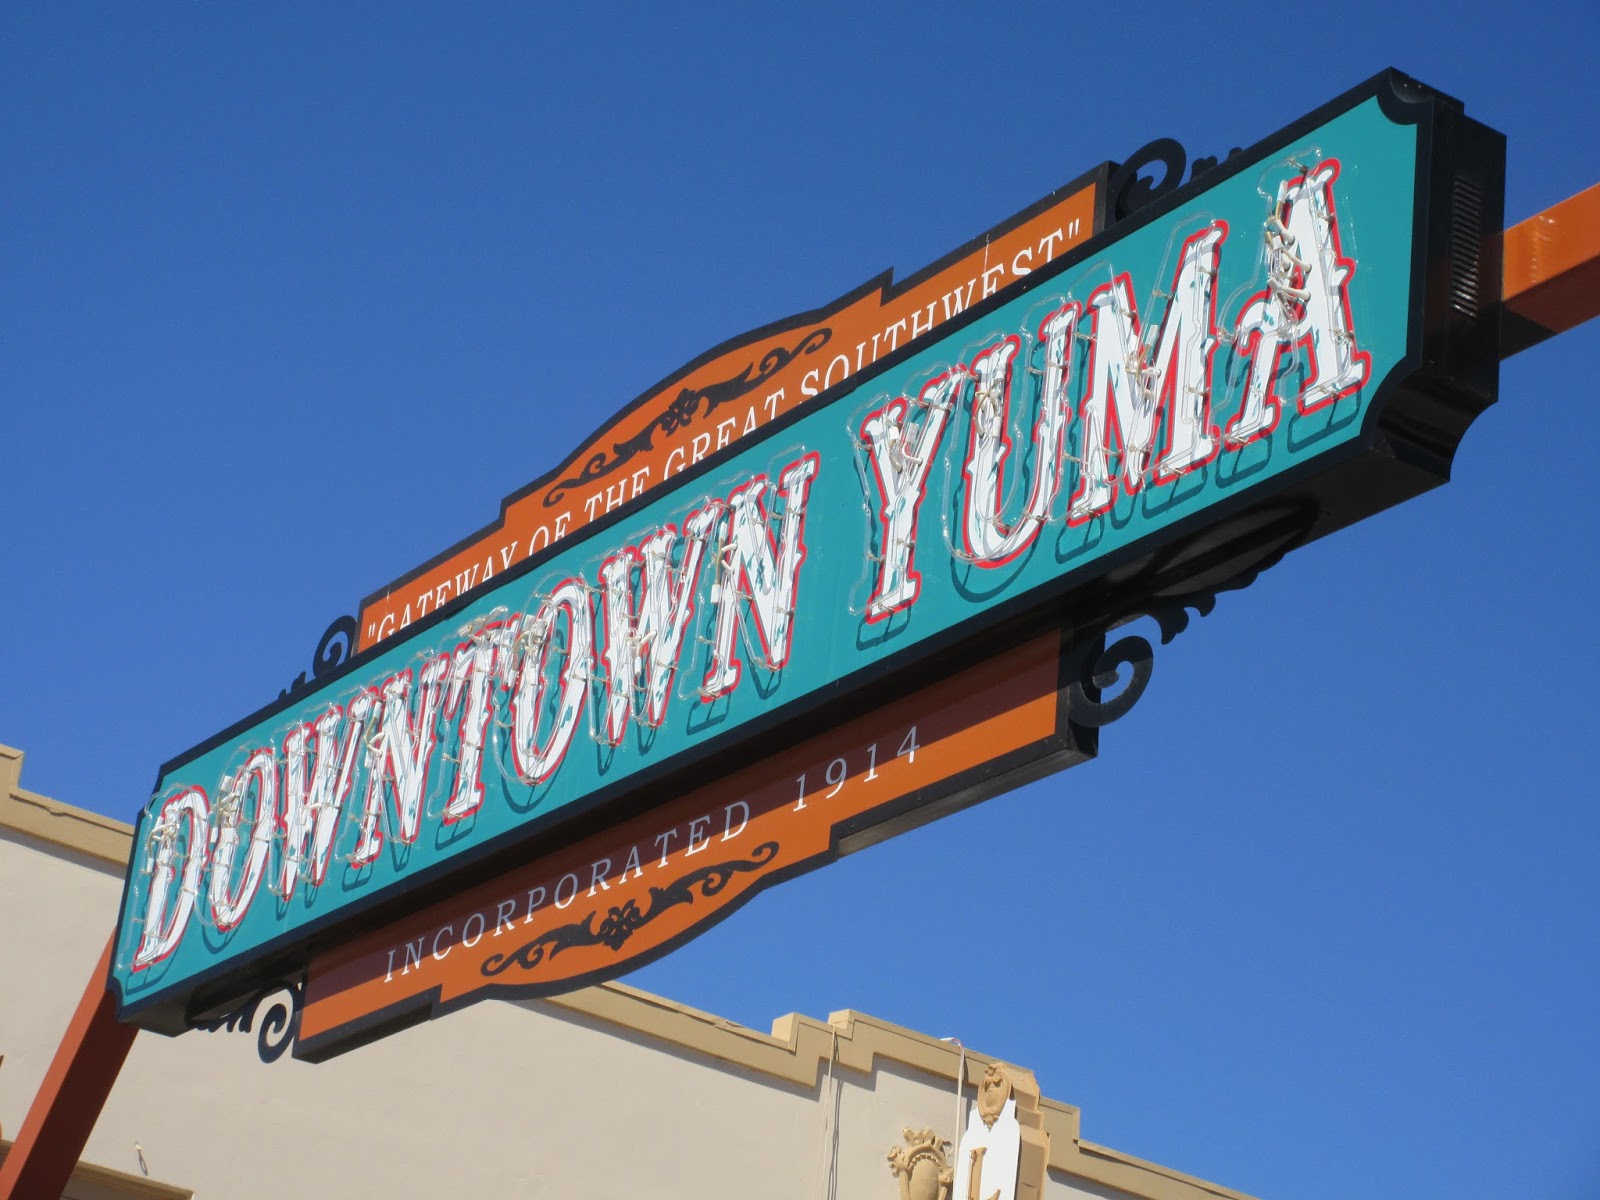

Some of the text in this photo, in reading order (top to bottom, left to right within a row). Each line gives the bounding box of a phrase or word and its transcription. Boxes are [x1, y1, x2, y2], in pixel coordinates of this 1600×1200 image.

[132, 158, 1372, 973] DOWNTOWN YUMA
[529, 511, 571, 556] OF
[584, 466, 650, 523] THE
[663, 387, 785, 482] GREAT
[383, 725, 921, 983] INCORPORATED 1914
